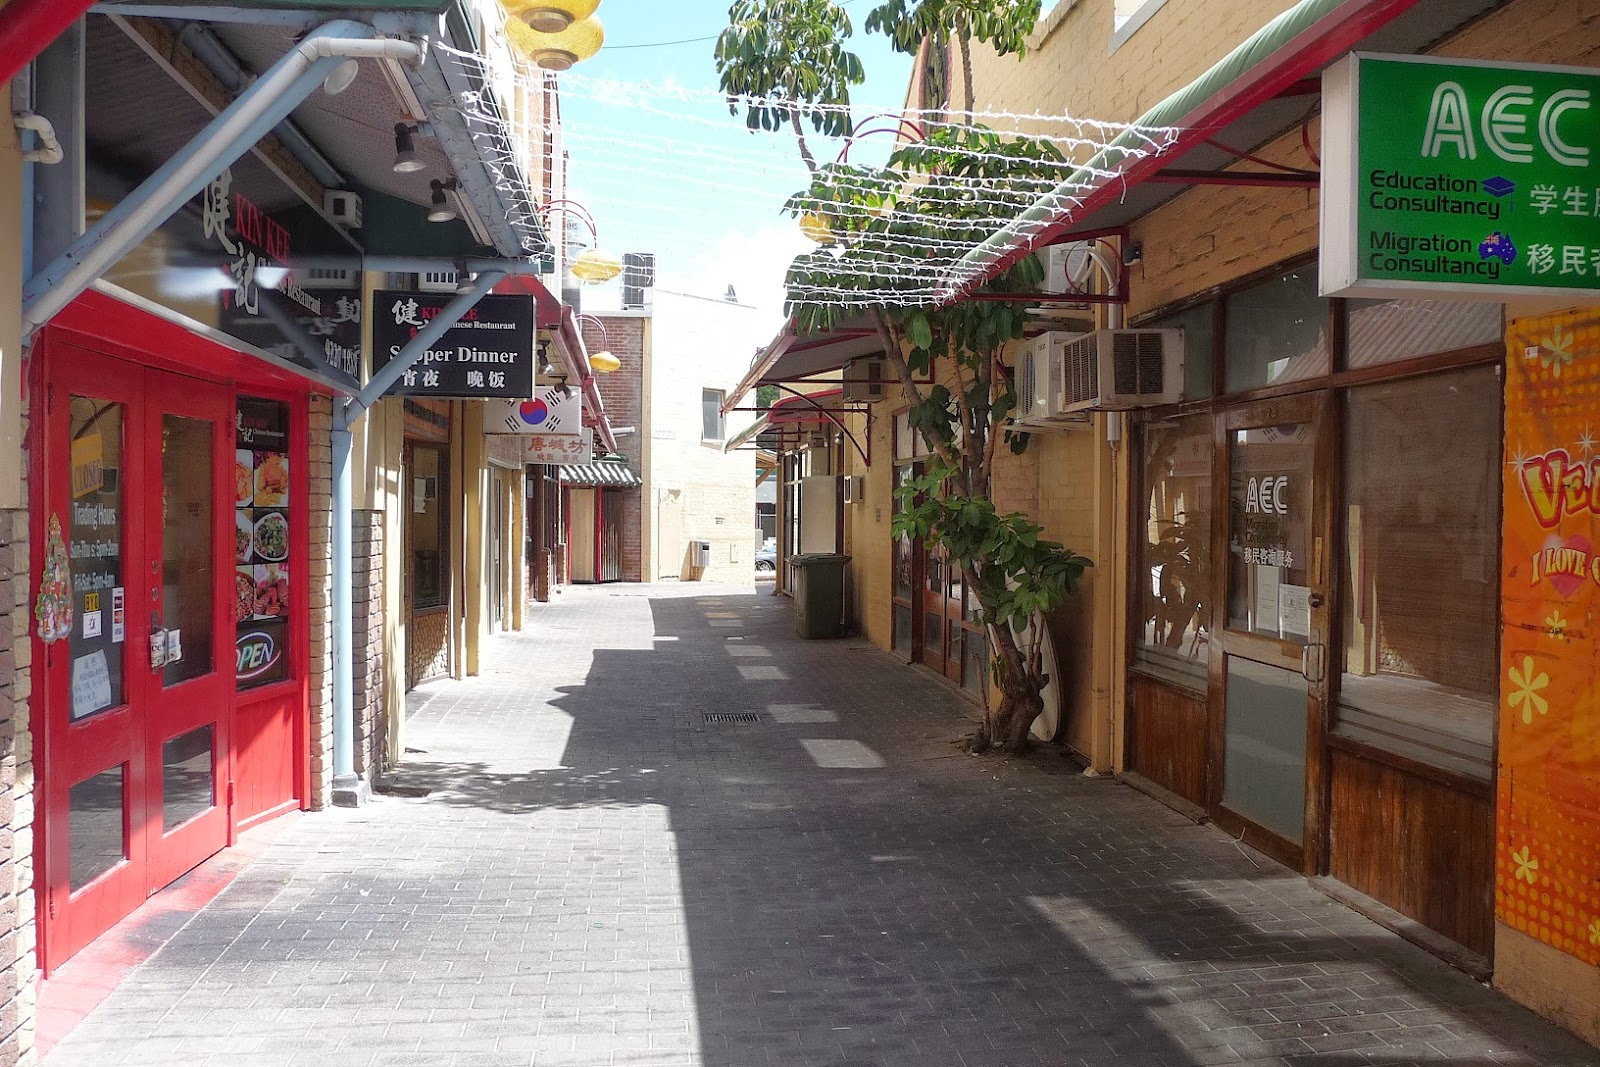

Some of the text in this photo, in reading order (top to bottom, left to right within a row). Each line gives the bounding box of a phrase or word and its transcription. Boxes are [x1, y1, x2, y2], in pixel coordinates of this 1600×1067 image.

[1421, 80, 1590, 167] AEC
[1370, 169, 1477, 193] Education
[1369, 191, 1500, 220] Consultancy
[1370, 230, 1472, 255] Migration
[1369, 252, 1500, 280] Consultancy
[287, 276, 322, 316] Restaurant
[474, 321, 516, 330] Restaurant
[457, 346, 519, 364] Dinner
[466, 370, 506, 388] 晚饭
[1245, 475, 1288, 515] AEC
[73, 502, 117, 531] Trading Hours
[1530, 551, 1543, 587] I
[1544, 546, 1588, 579] LOVE
